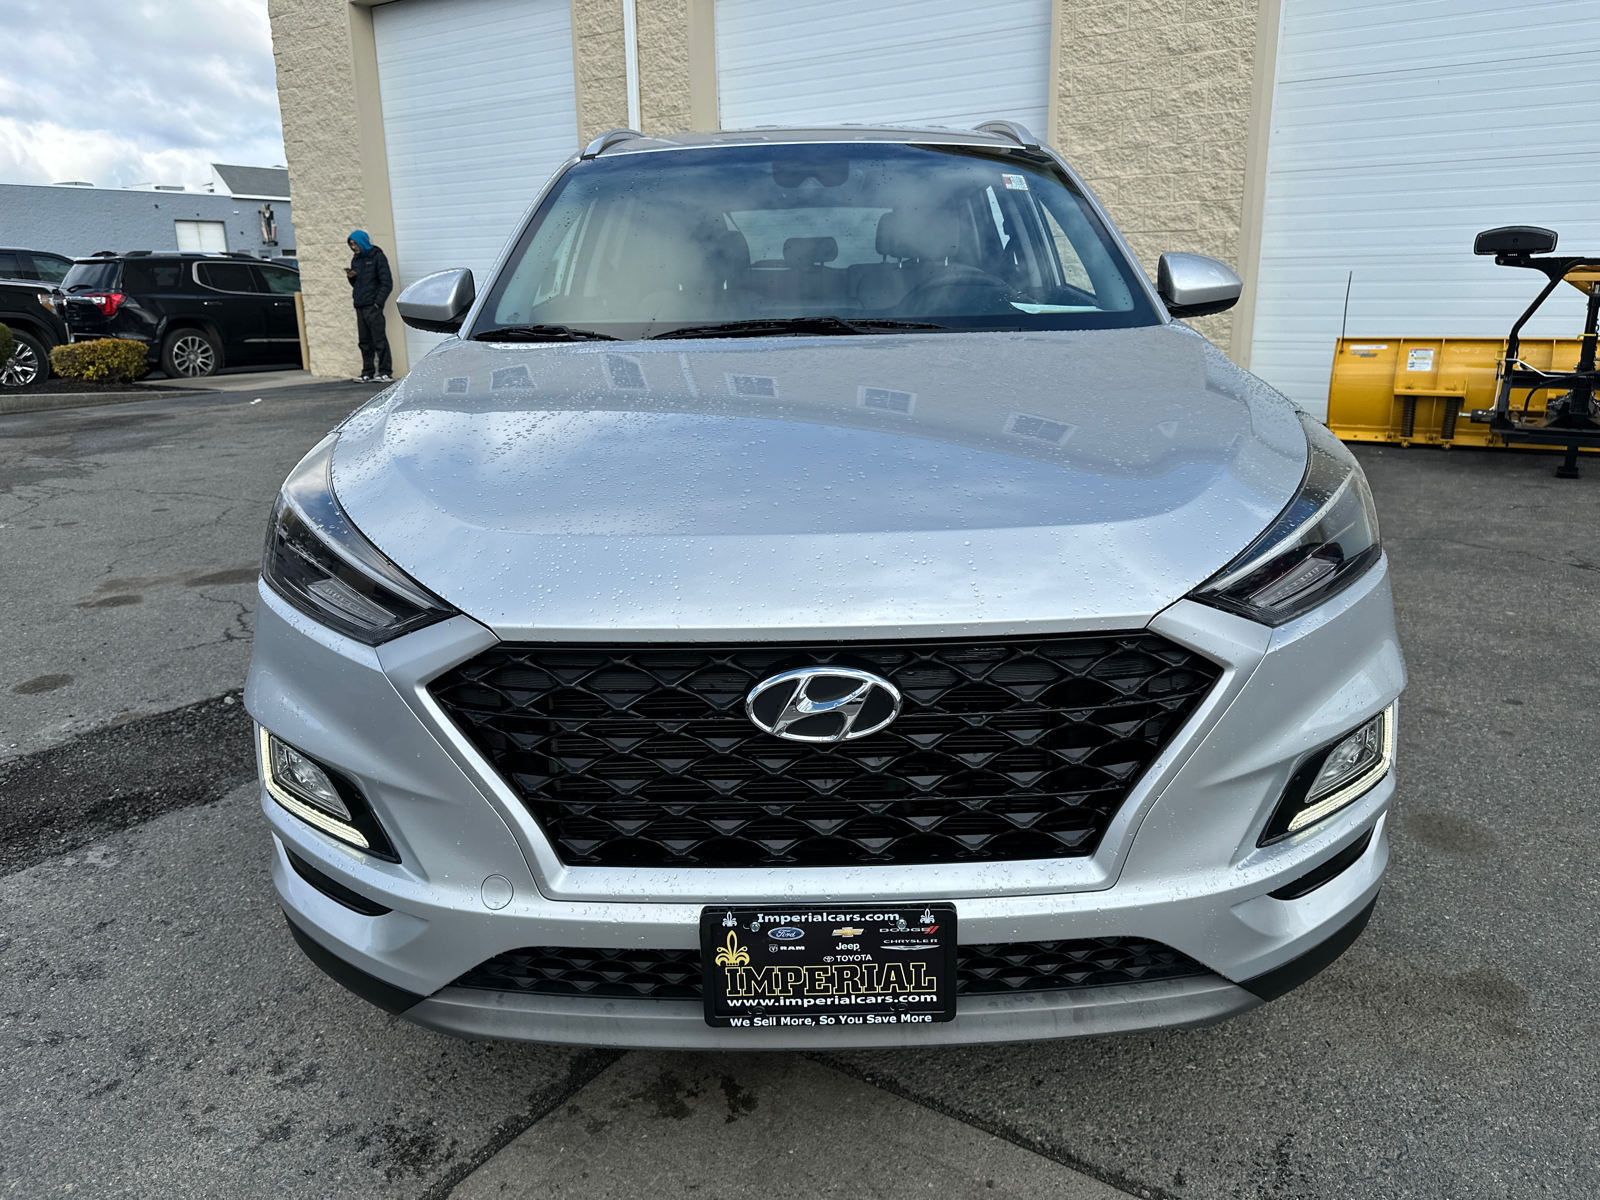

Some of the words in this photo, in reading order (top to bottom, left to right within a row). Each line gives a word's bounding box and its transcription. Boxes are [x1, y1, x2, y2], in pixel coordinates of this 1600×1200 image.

[757, 912, 900, 925] Imperialcars.com
[776, 929, 796, 938] Ford
[836, 942, 860, 952] Jeep
[836, 954, 873, 962] TOYOTA
[725, 963, 937, 997] IMPERIAL
[727, 994, 938, 1007] www.imperialcars.com
[730, 1017, 750, 1027] We
[754, 1016, 777, 1026] Sell
[780, 1016, 816, 1027] More,
[819, 1016, 835, 1025] So
[839, 1015, 863, 1025] You
[866, 1014, 897, 1024] Save
[900, 1014, 932, 1024] More
